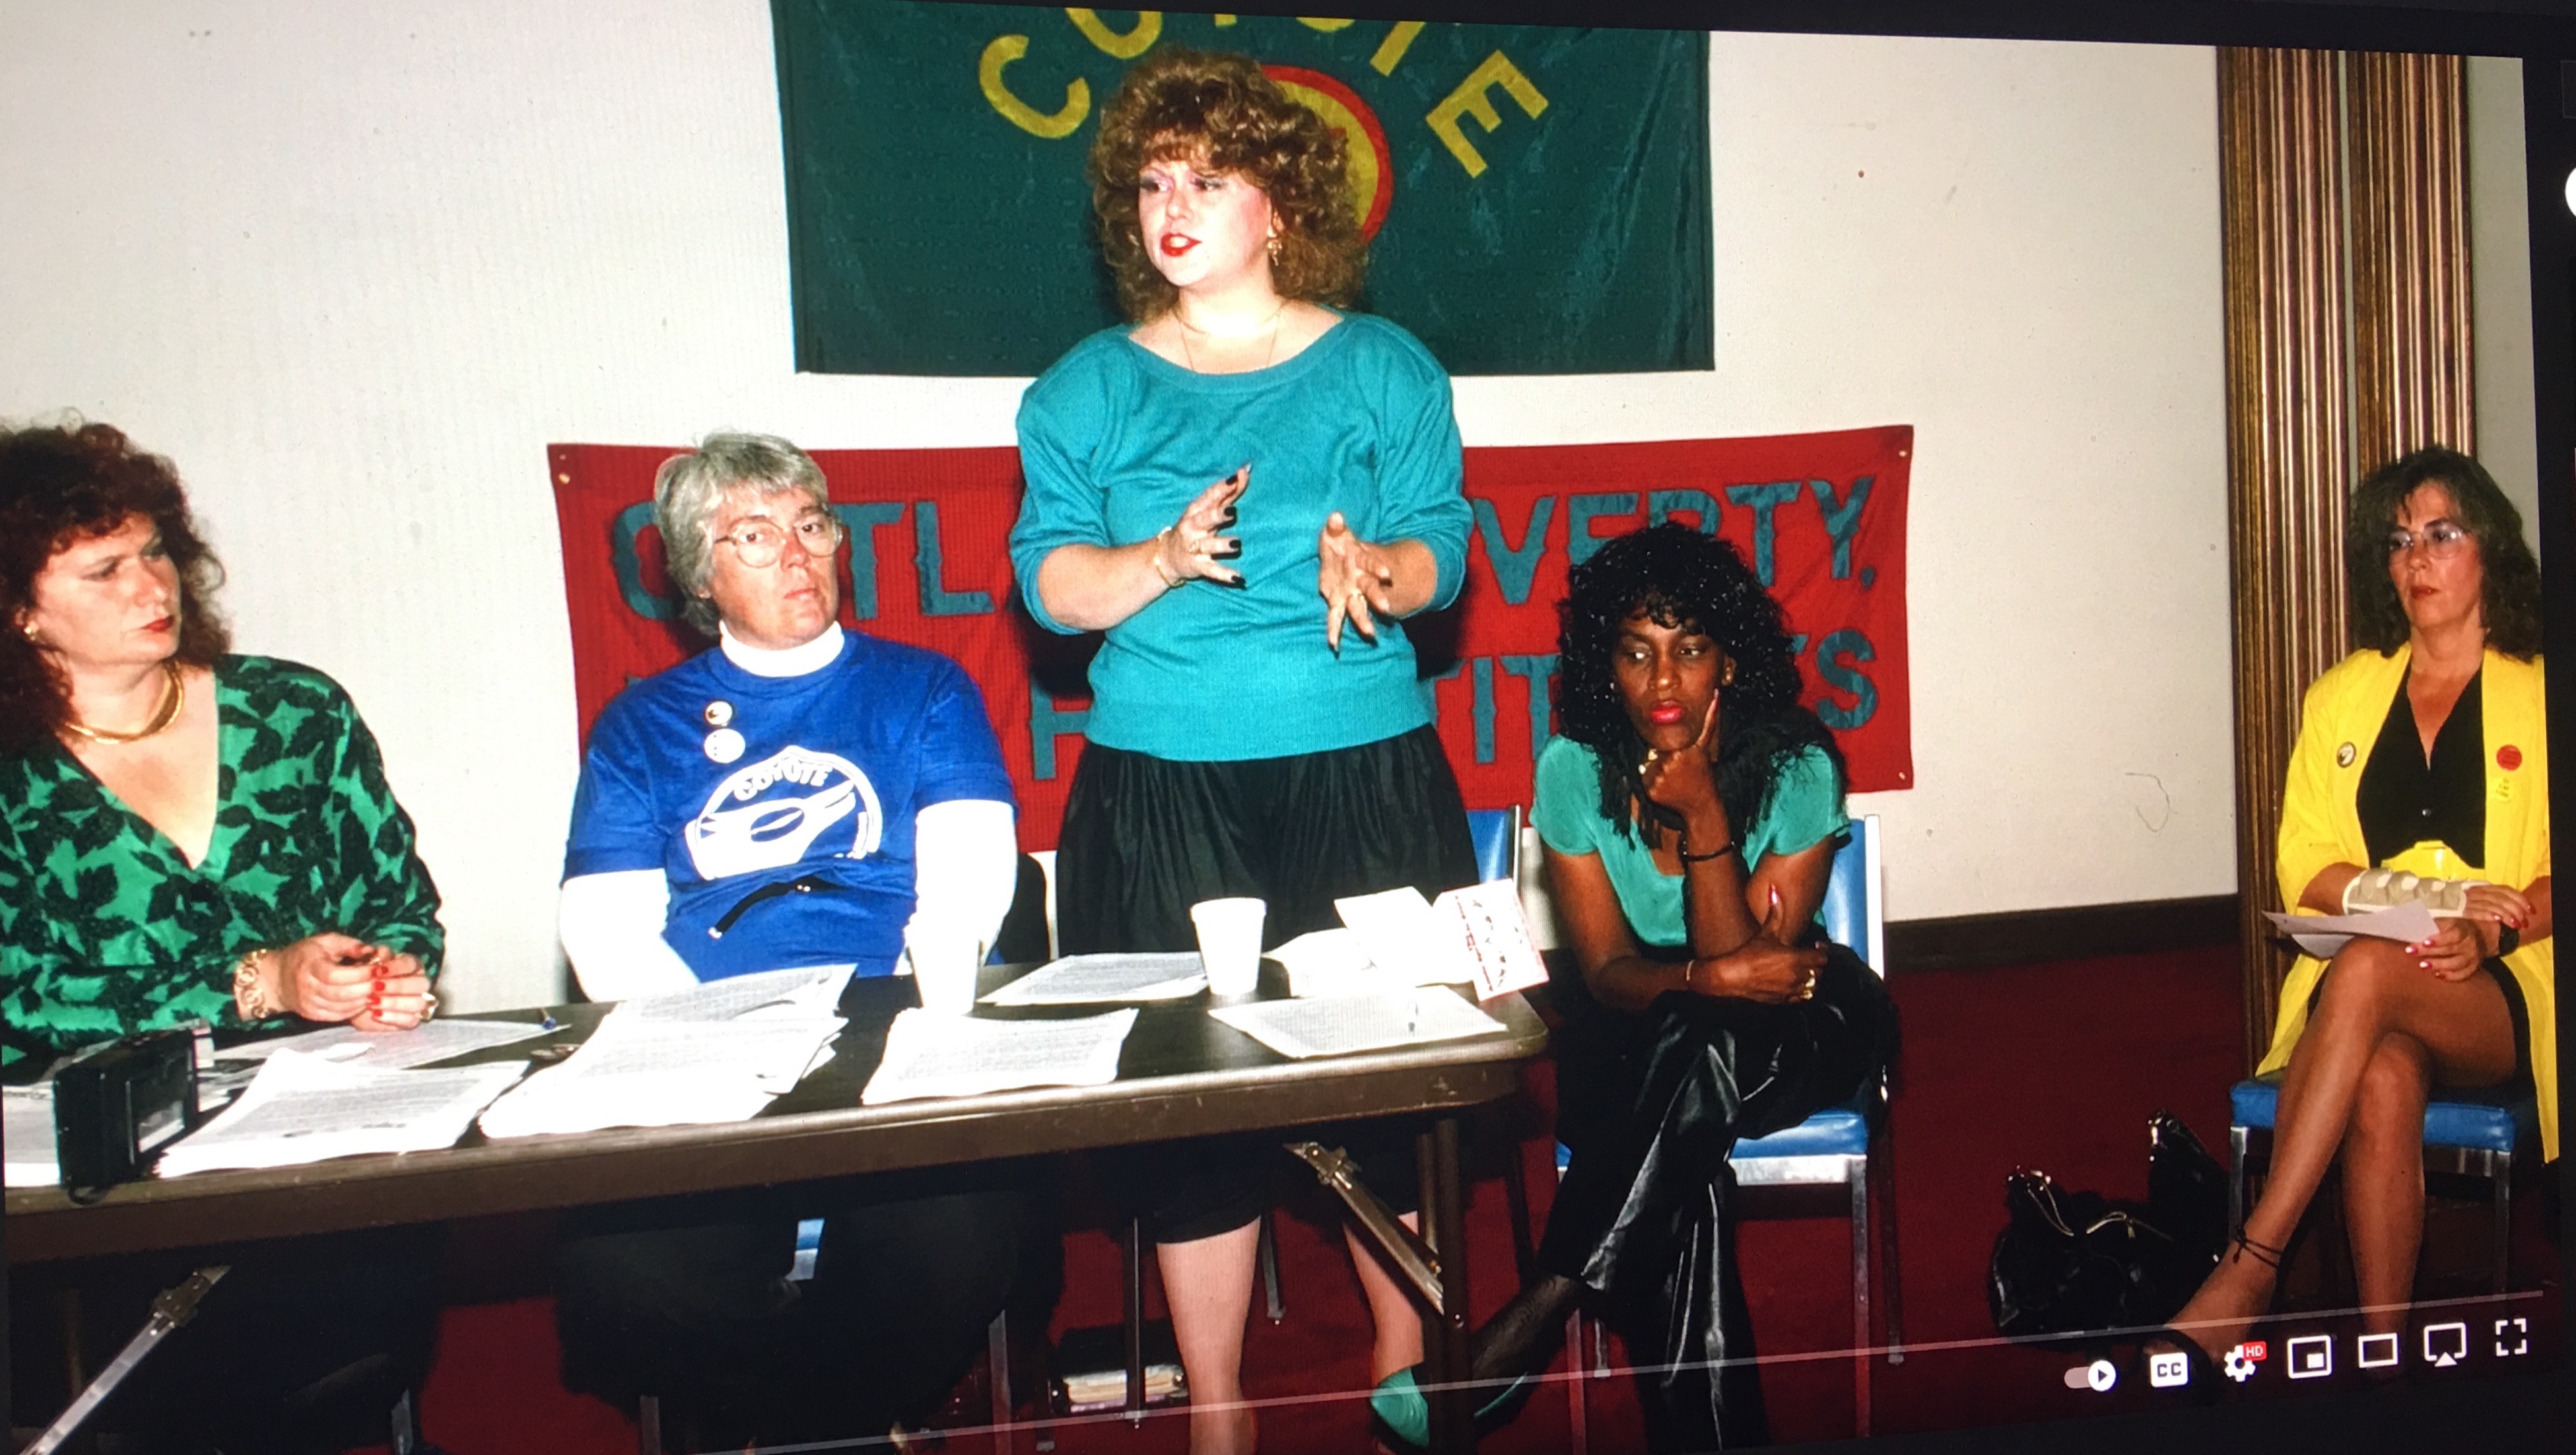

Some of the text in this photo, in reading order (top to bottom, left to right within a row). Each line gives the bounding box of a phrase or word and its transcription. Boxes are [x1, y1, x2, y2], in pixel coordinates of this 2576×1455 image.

[978, 7, 1549, 178] COE
[733, 759, 834, 801] COYOTE
[2245, 1345, 2264, 1358] HD
[2157, 1362, 2182, 1378] CC
